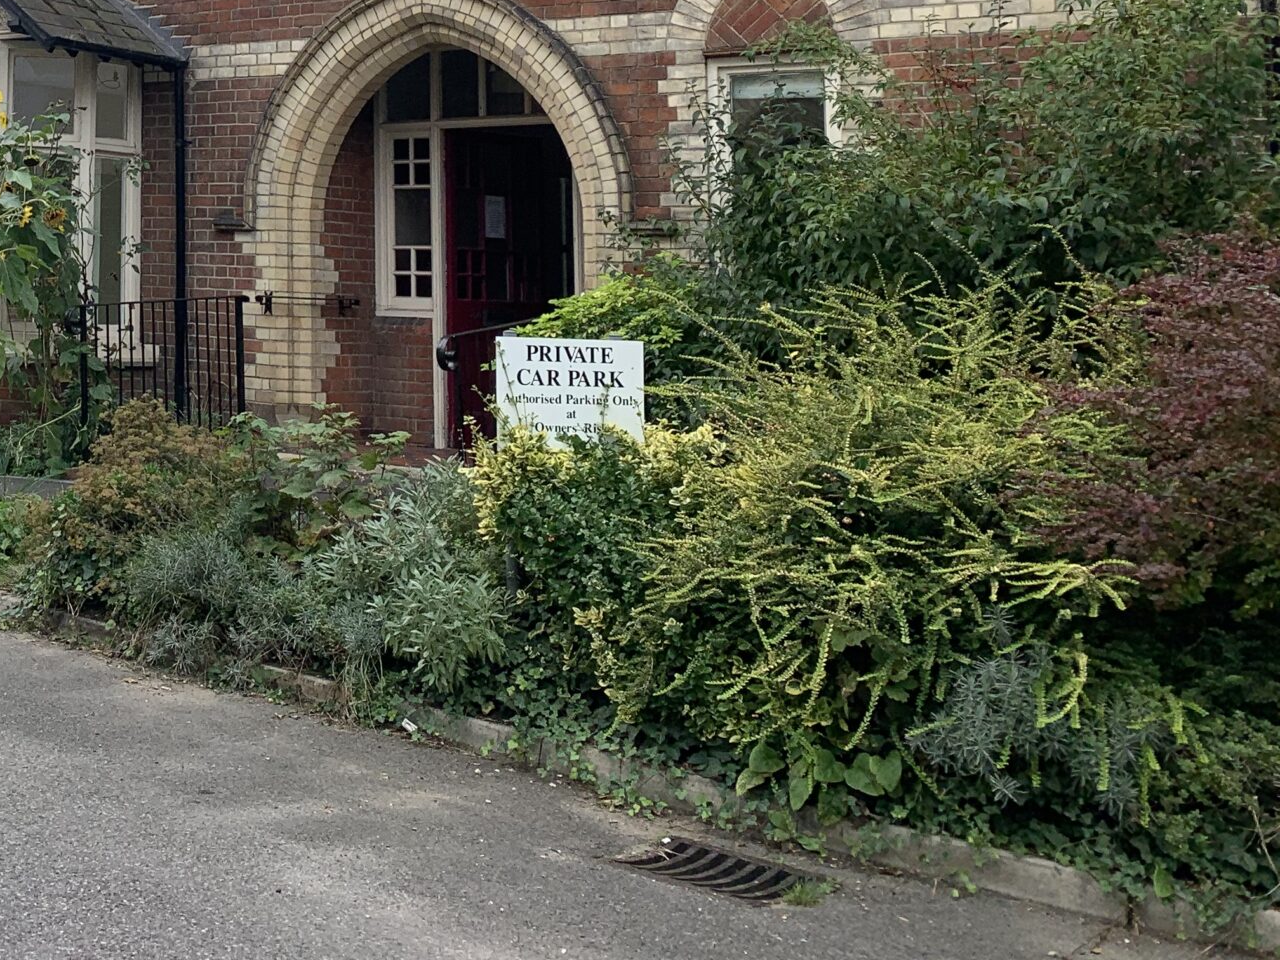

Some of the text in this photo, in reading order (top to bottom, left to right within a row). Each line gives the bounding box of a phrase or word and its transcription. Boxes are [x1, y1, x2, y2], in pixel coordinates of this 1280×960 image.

[526, 345, 614, 364] PRIVATE
[517, 369, 624, 388] CAR PARK
[503, 393, 638, 409] Authorised Parking Only
[566, 409, 576, 418] at
[585, 424, 606, 433] Ris
